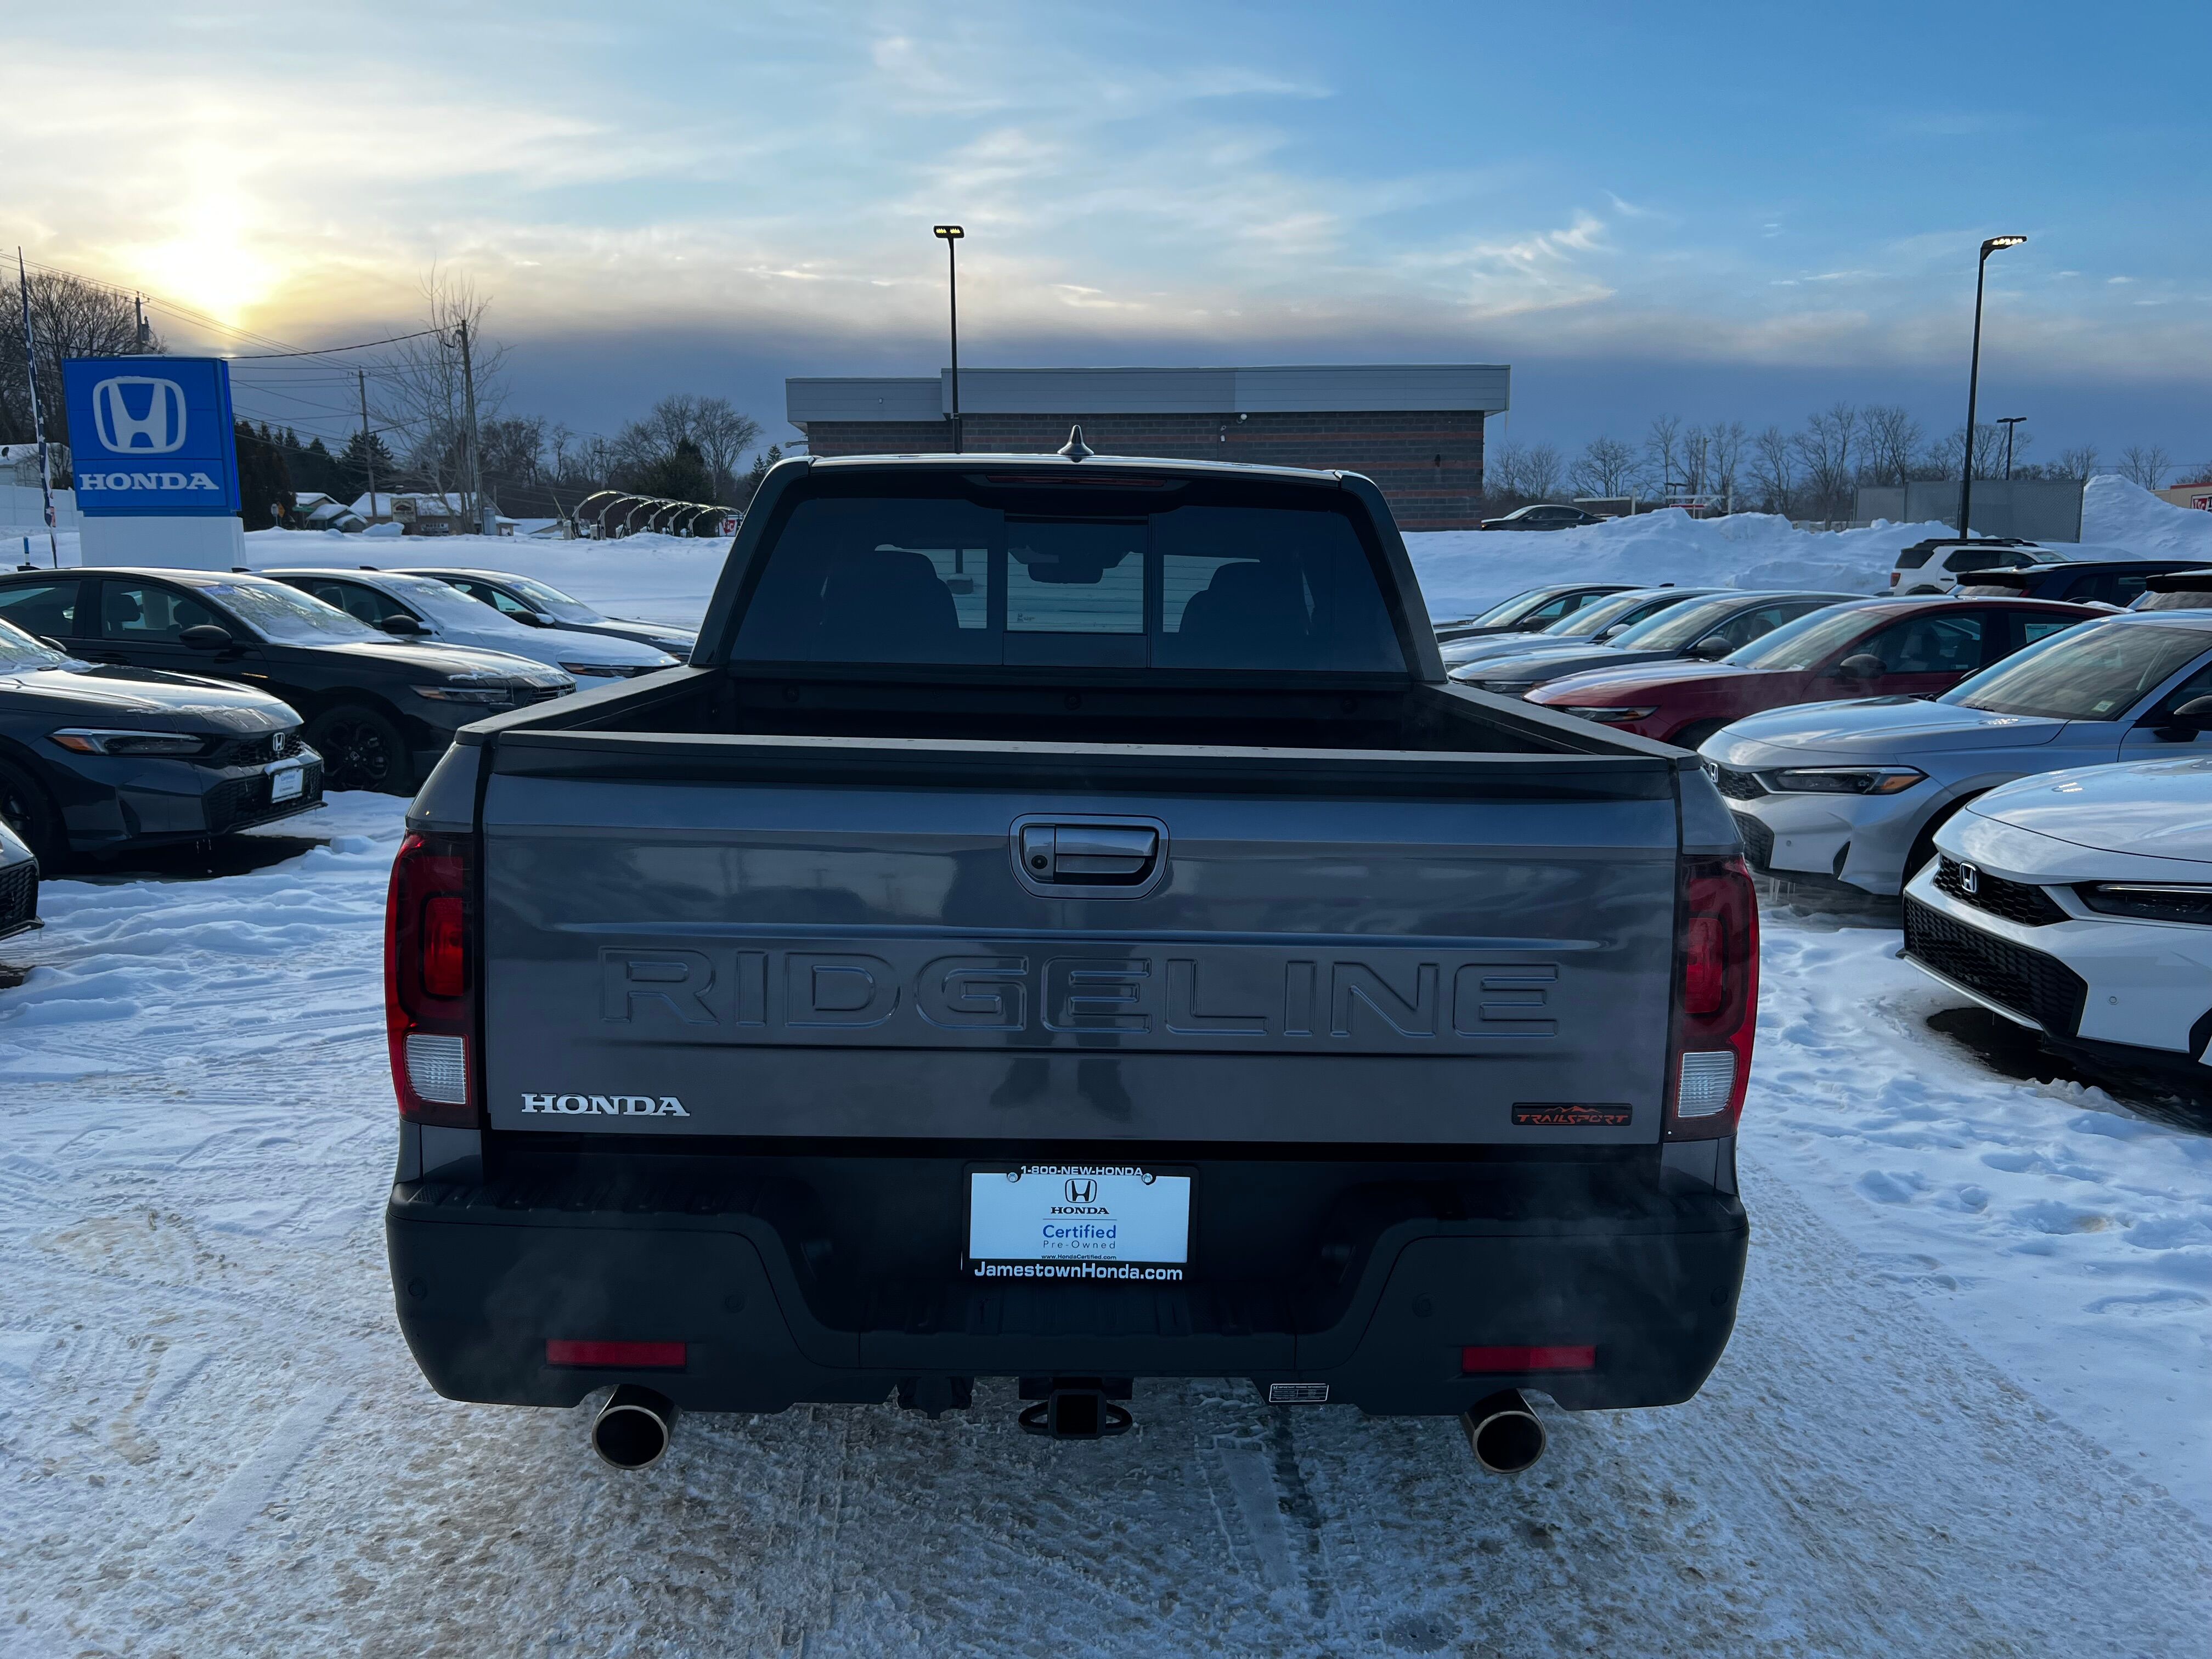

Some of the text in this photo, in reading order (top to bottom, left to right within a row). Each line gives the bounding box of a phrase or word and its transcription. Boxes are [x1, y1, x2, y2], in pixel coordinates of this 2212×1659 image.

[79, 472, 219, 490] HONDA
[599, 946, 1559, 1038] RIDGELINE
[521, 1093, 690, 1117] HONDA
[1517, 1114, 1628, 1125] TRAILSPORT
[1021, 1165, 1143, 1176] 1-800-NEW-HONDA
[1051, 1206, 1110, 1215] HONDA
[1043, 1224, 1116, 1238] Certified
[1043, 1240, 1115, 1249] Pre-Owned
[975, 1261, 1183, 1280] JamestownHonda.com
